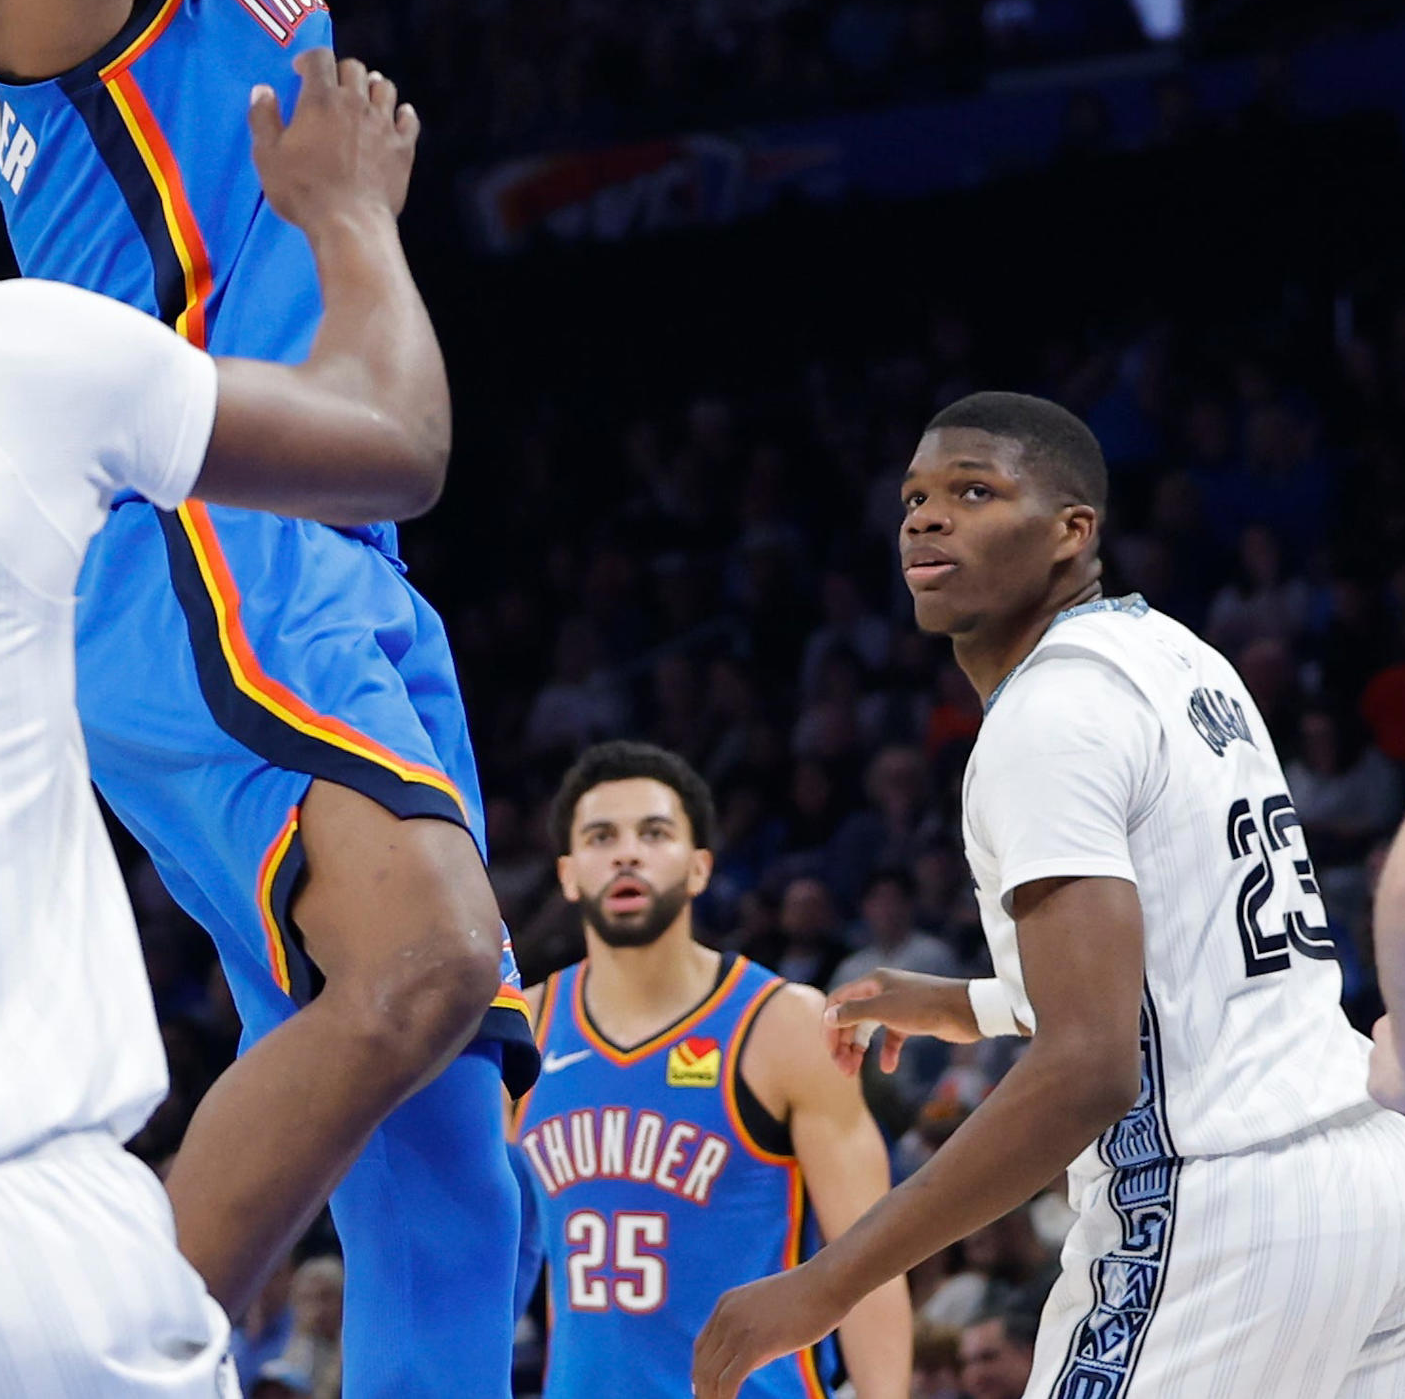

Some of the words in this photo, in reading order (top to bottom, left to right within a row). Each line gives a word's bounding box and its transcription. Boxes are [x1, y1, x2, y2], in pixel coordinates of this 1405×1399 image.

[1227, 794, 1338, 977] 23
[520, 1106, 730, 1207] THUNDER
[566, 1208, 668, 1315] 25
